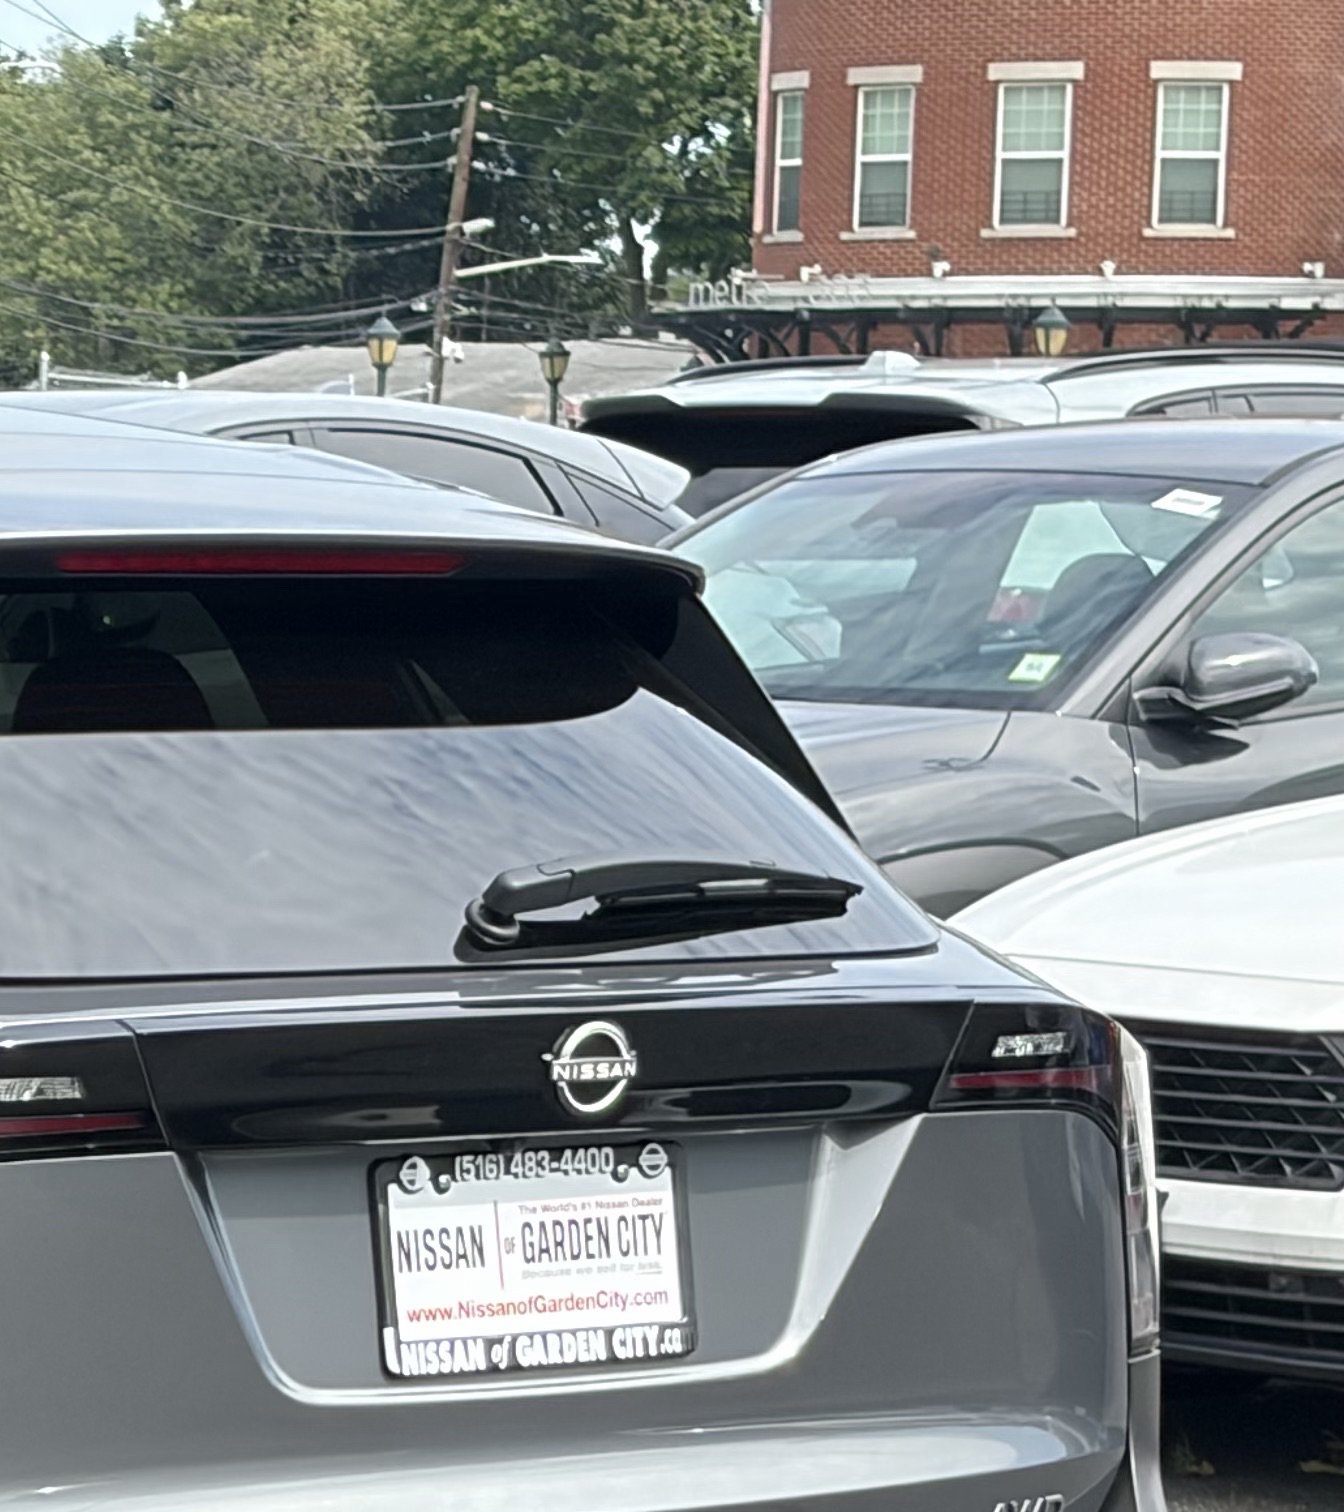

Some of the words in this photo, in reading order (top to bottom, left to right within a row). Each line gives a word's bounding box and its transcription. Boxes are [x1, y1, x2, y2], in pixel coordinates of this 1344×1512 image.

[552, 1061, 637, 1081] NISSAN
[454, 1154, 504, 1182] (516)
[510, 1147, 613, 1178] 483-4400
[396, 1225, 485, 1274] NISSAN
[503, 1236, 516, 1255] OF
[520, 1215, 612, 1265] GARDEN
[617, 1211, 664, 1258] CITY
[407, 1289, 669, 1323] www.NissanofGardenCity.com
[400, 1337, 487, 1376] NISSAN
[490, 1335, 512, 1370] of
[515, 1328, 607, 1368] GARDEN
